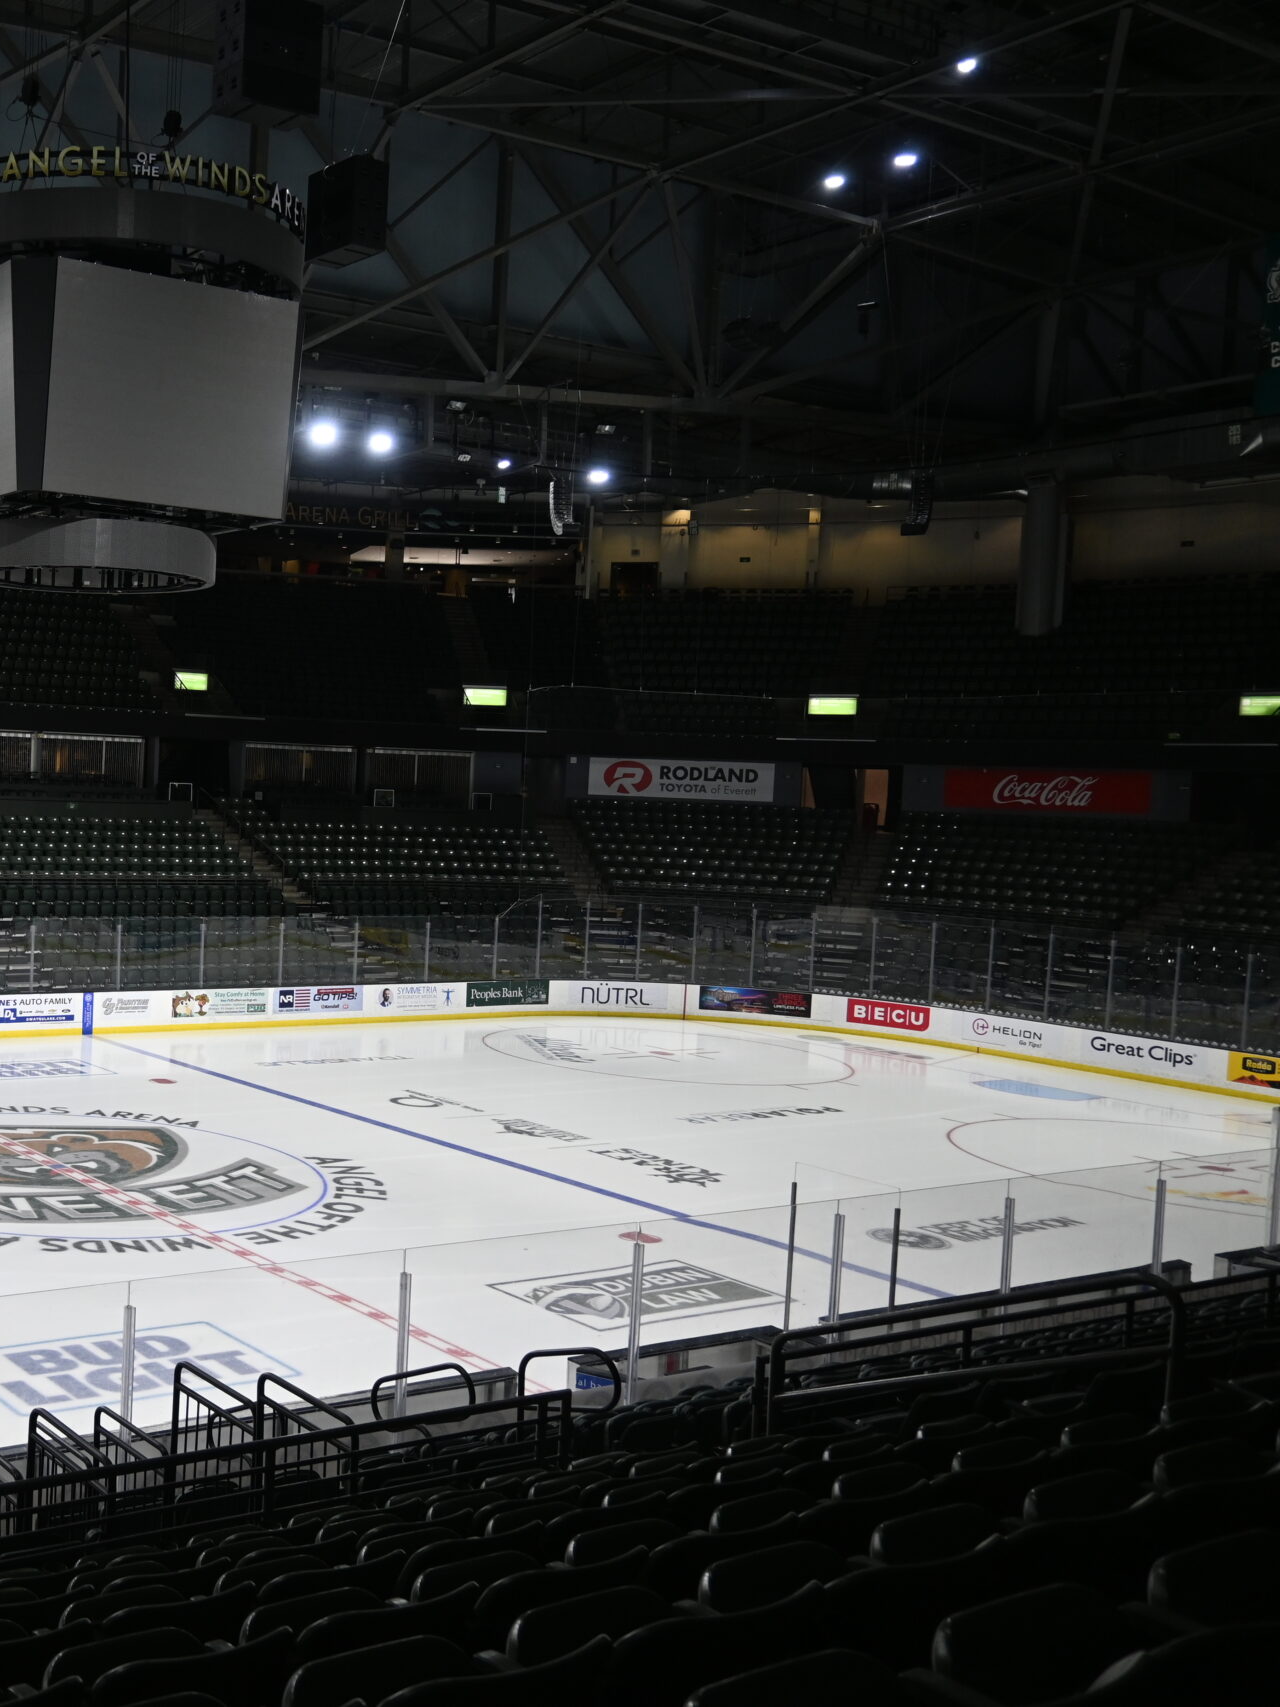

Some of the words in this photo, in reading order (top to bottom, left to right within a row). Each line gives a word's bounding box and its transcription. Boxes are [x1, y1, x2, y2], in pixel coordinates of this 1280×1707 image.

[2, 146, 128, 183] ANGEL
[136, 151, 157, 164] OF
[133, 164, 160, 177] THE
[164, 149, 270, 204] WINDS
[285, 502, 350, 524] ARENA
[358, 506, 417, 528] GRILL
[659, 765, 759, 783] RODLAND
[659, 783, 707, 794] TOYOTA
[710, 785, 721, 795] of
[723, 785, 757, 796] Everett
[313, 994, 331, 1002] GO
[332, 992, 358, 1001] TIPS!
[397, 986, 437, 995] SYMMETRIA
[471, 988, 500, 1001] Peoples
[502, 987, 523, 998] Bank
[19, 998, 43, 1006] AUTO
[44, 997, 73, 1005] FAMILY
[992, 1024, 1043, 1041] HELION
[1028, 1040, 1042, 1049] Tips!
[1090, 1035, 1144, 1058] Great
[1148, 1045, 1194, 1068] Clips
[84, 1108, 201, 1128] ARENA
[303, 1156, 388, 1201] ANGEL
[315, 1201, 365, 1223] OF
[232, 1219, 338, 1245] THE
[39, 1237, 214, 1254] WINDS
[642, 1288, 721, 1308] LAW
[3, 1335, 191, 1376] BUD
